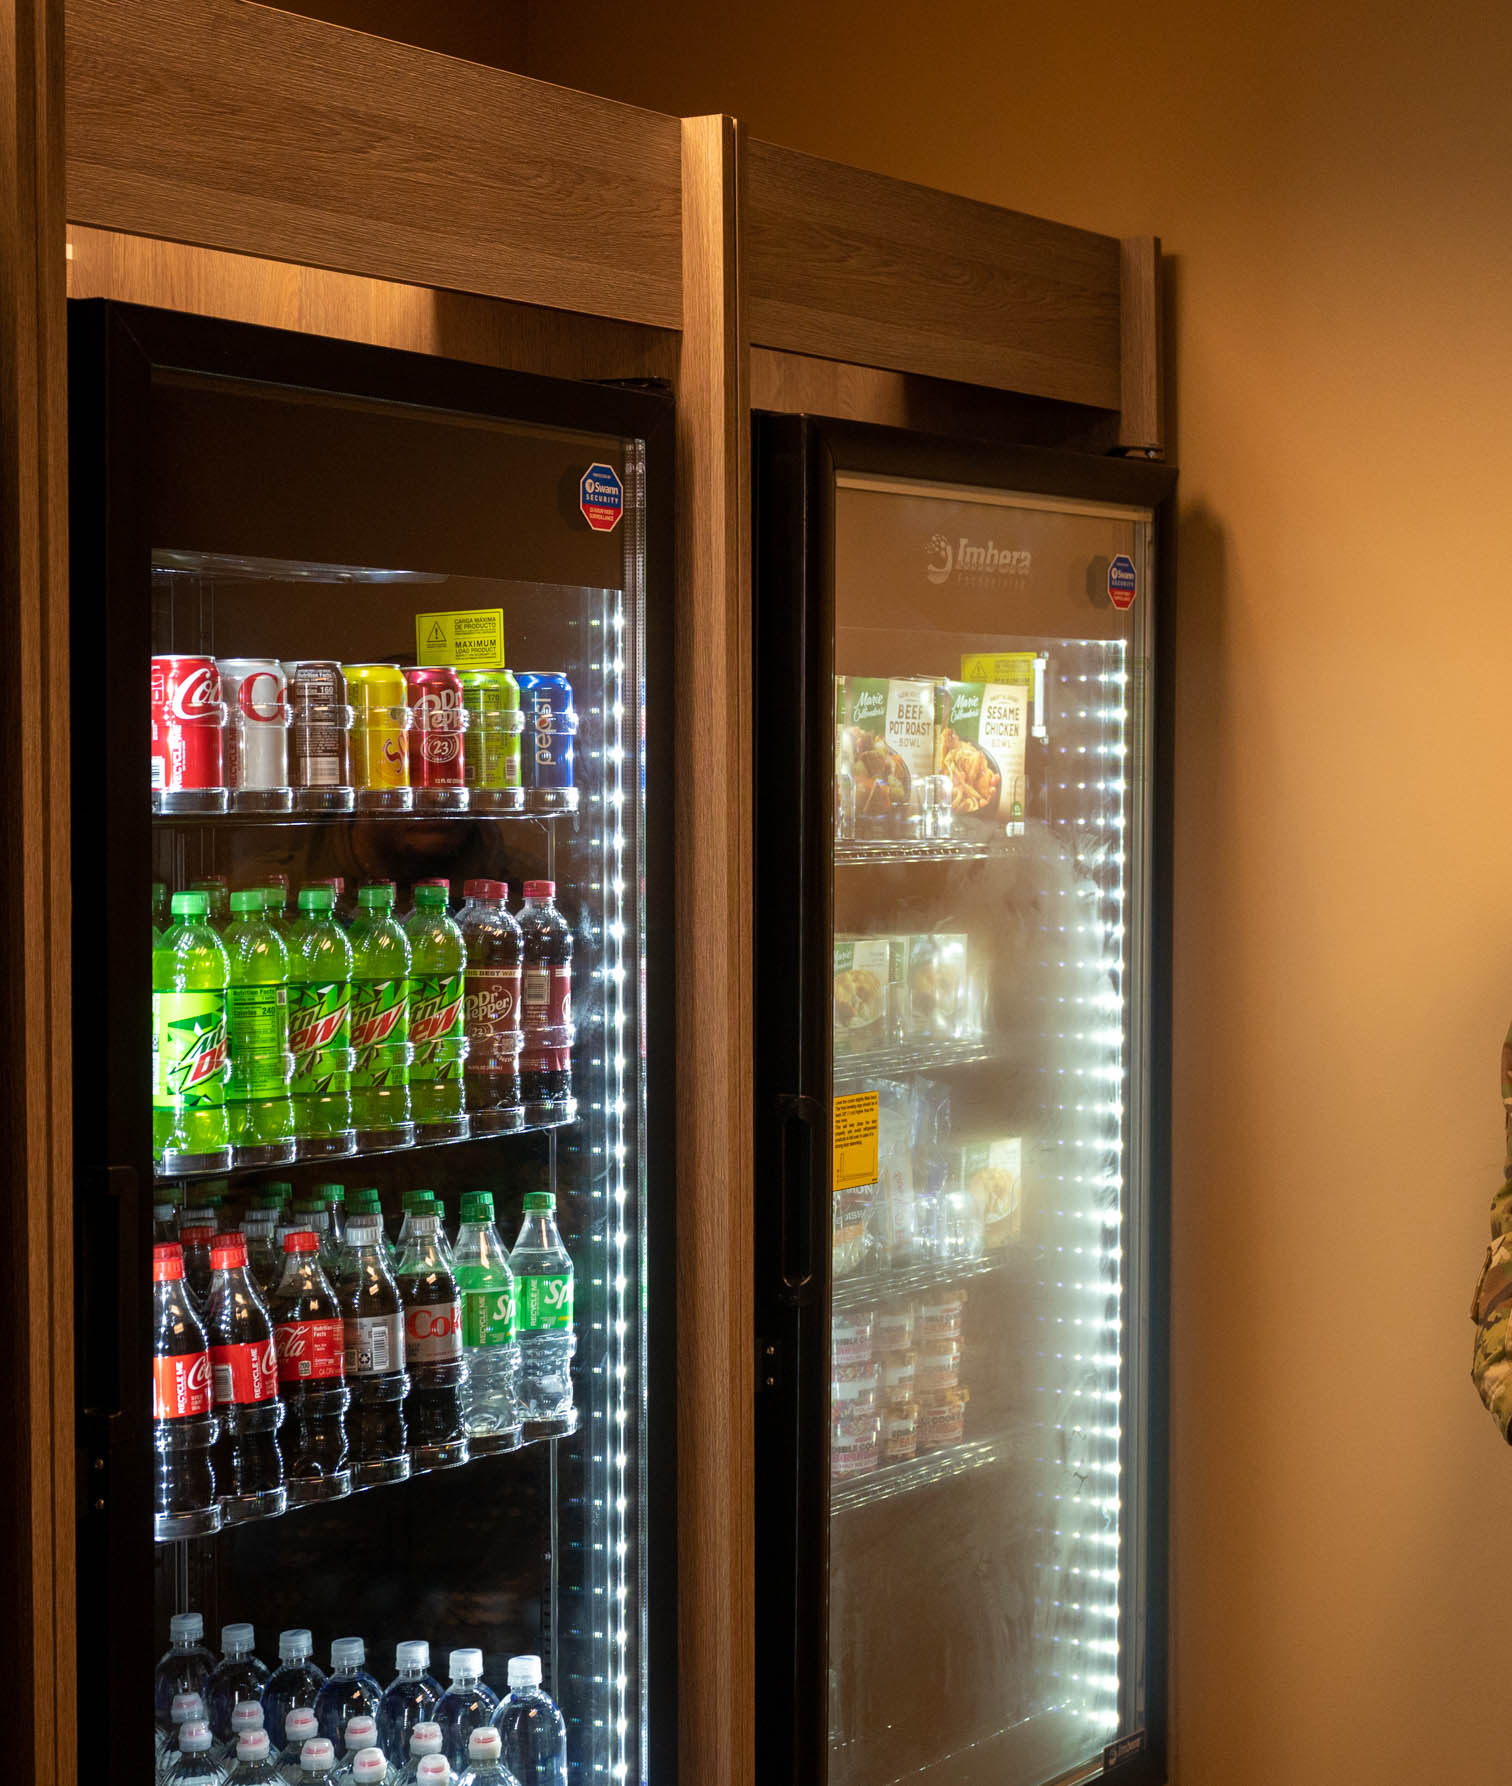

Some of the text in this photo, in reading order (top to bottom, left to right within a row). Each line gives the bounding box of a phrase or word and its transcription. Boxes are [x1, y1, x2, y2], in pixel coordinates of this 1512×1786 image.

[585, 493, 619, 504] SECURITY
[455, 640, 496, 648] MAXIMUM
[897, 704, 924, 719] BEEF
[986, 705, 1020, 721] SESAME
[889, 720, 931, 737] POT ROAST
[985, 722, 1019, 737] CHICKEN
[433, 740, 449, 755] 23
[479, 990, 499, 1006] Dr
[262, 1006, 275, 1015] 240
[464, 995, 510, 1021] Pepper
[290, 1002, 348, 1053] ew
[351, 998, 407, 1048] ew
[409, 996, 464, 1043] ew
[530, 1293, 538, 1327] RECYCLE
[479, 1308, 487, 1344] RECYCLE
[250, 1361, 262, 1399] RECYCLE
[175, 1376, 185, 1414] RECYCLE
